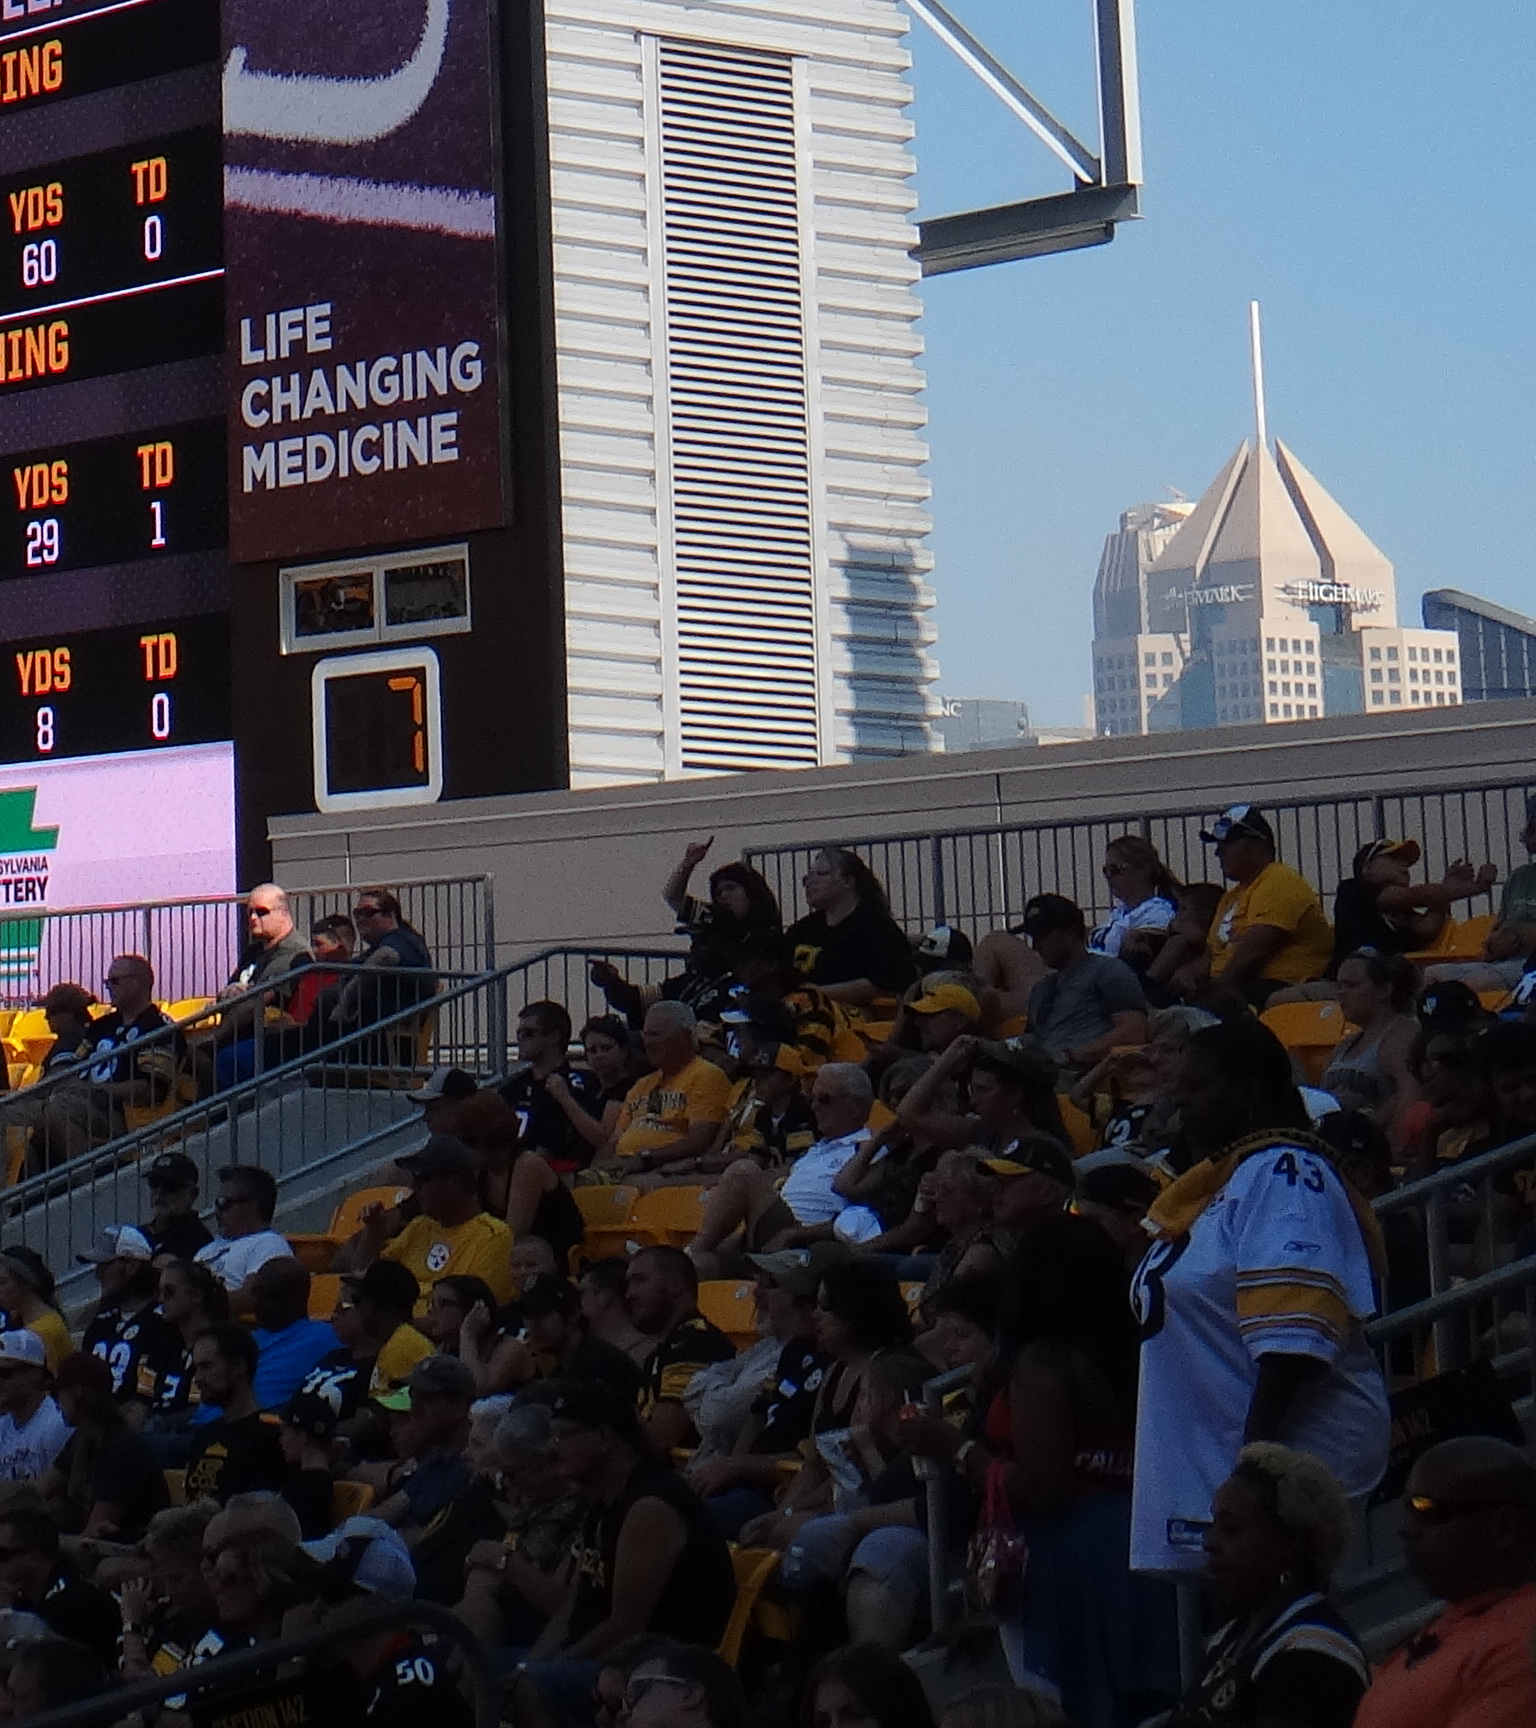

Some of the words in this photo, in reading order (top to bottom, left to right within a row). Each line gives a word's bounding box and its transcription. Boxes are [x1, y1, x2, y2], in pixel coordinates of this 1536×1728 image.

[132, 156, 168, 205] TD
[10, 183, 64, 234] YDS
[144, 214, 162, 260] 0
[23, 239, 57, 286] 60
[240, 302, 333, 366] LIFE
[240, 341, 483, 429] CHANGING
[138, 441, 174, 490] TD
[242, 411, 460, 493] MEDICINE
[14, 460, 69, 510] YDS
[27, 519, 59, 568] 29
[151, 501, 166, 547] 1
[17, 646, 71, 696] YDS
[141, 632, 177, 680] TD
[37, 706, 54, 753] 8
[152, 692, 171, 740] 0
[387, 677, 425, 773] 7
[1272, 1151, 1325, 1193] 43
[395, 1656, 436, 1687] 50
